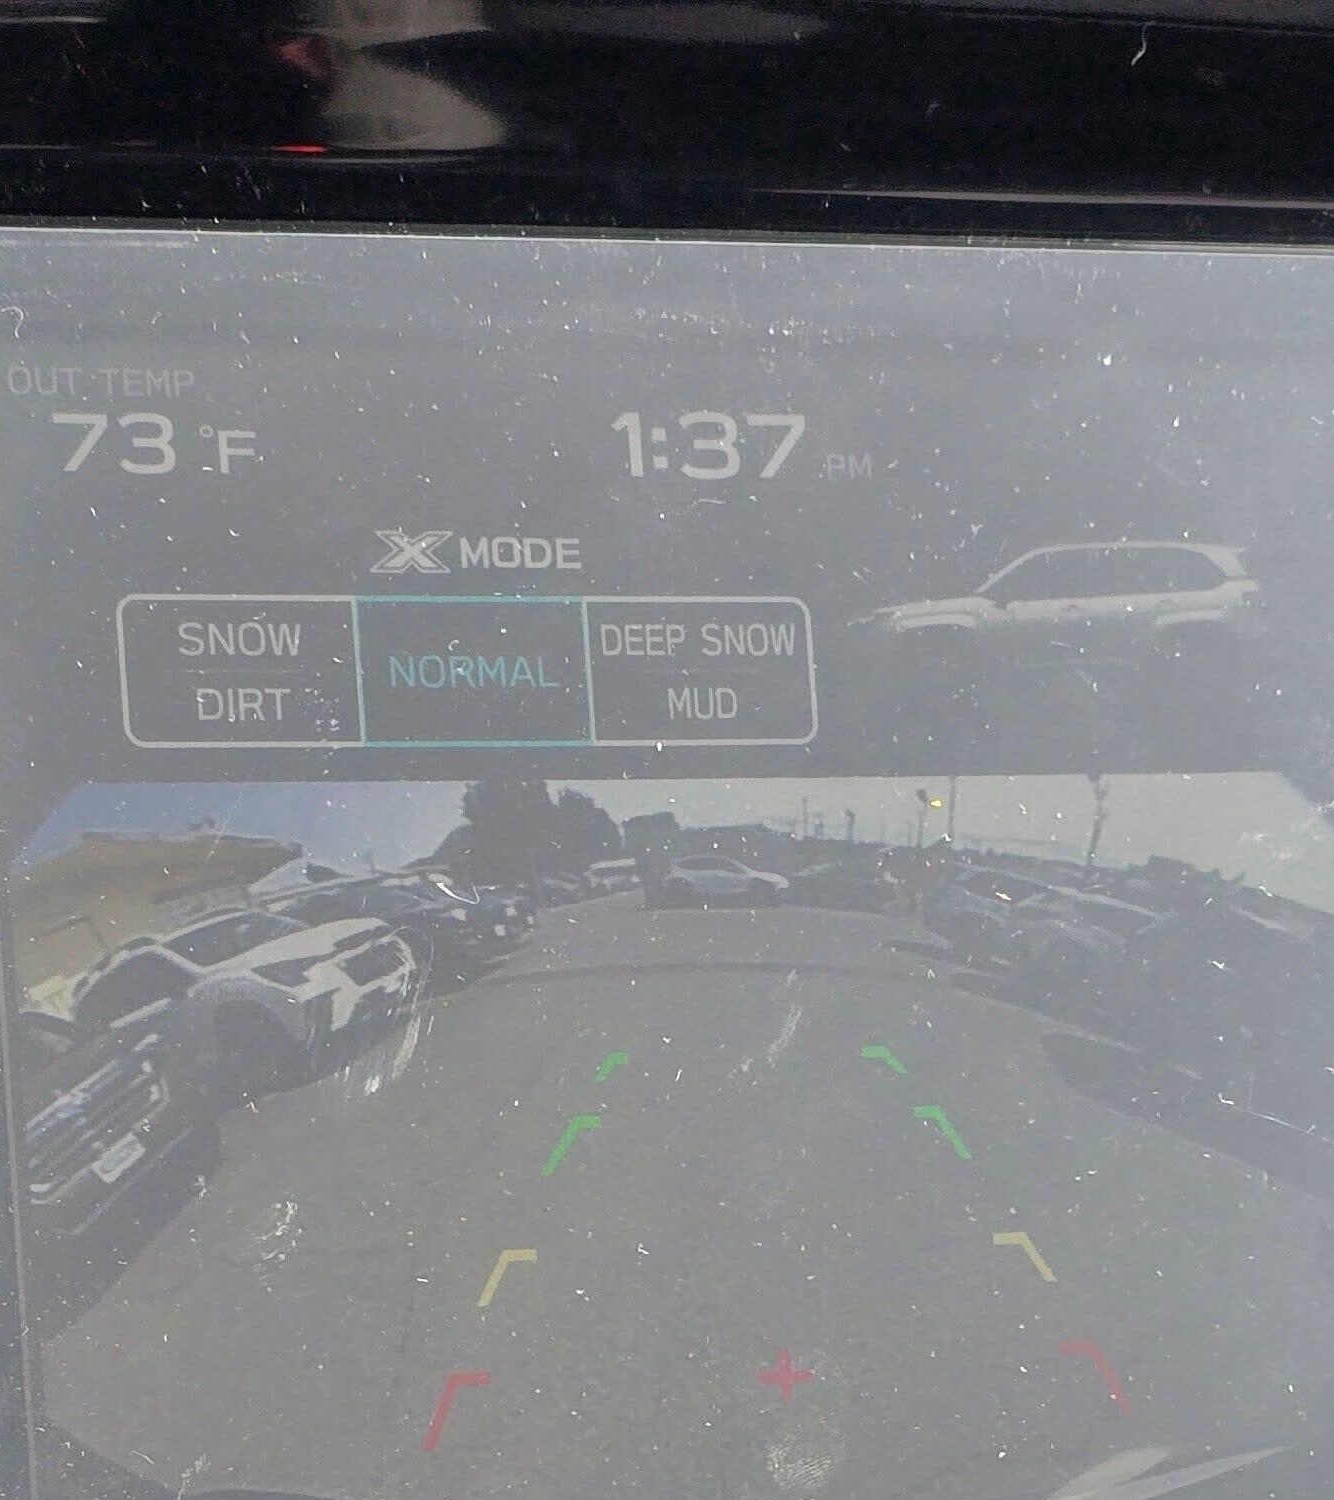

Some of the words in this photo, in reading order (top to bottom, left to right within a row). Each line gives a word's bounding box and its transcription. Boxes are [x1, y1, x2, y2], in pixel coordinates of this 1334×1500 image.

[7, 366, 83, 395] OUT
[99, 368, 195, 399] TEMP
[51, 411, 177, 475] 73
[609, 411, 807, 481] 1:37
[826, 454, 873, 480] PM
[459, 537, 583, 571] MODE
[178, 621, 303, 658] SNOW
[600, 622, 687, 658] DEEP
[700, 623, 797, 659] SNOW
[388, 654, 560, 691] NORMAL
[196, 687, 291, 723] DIRT
[666, 687, 740, 721] MUD
